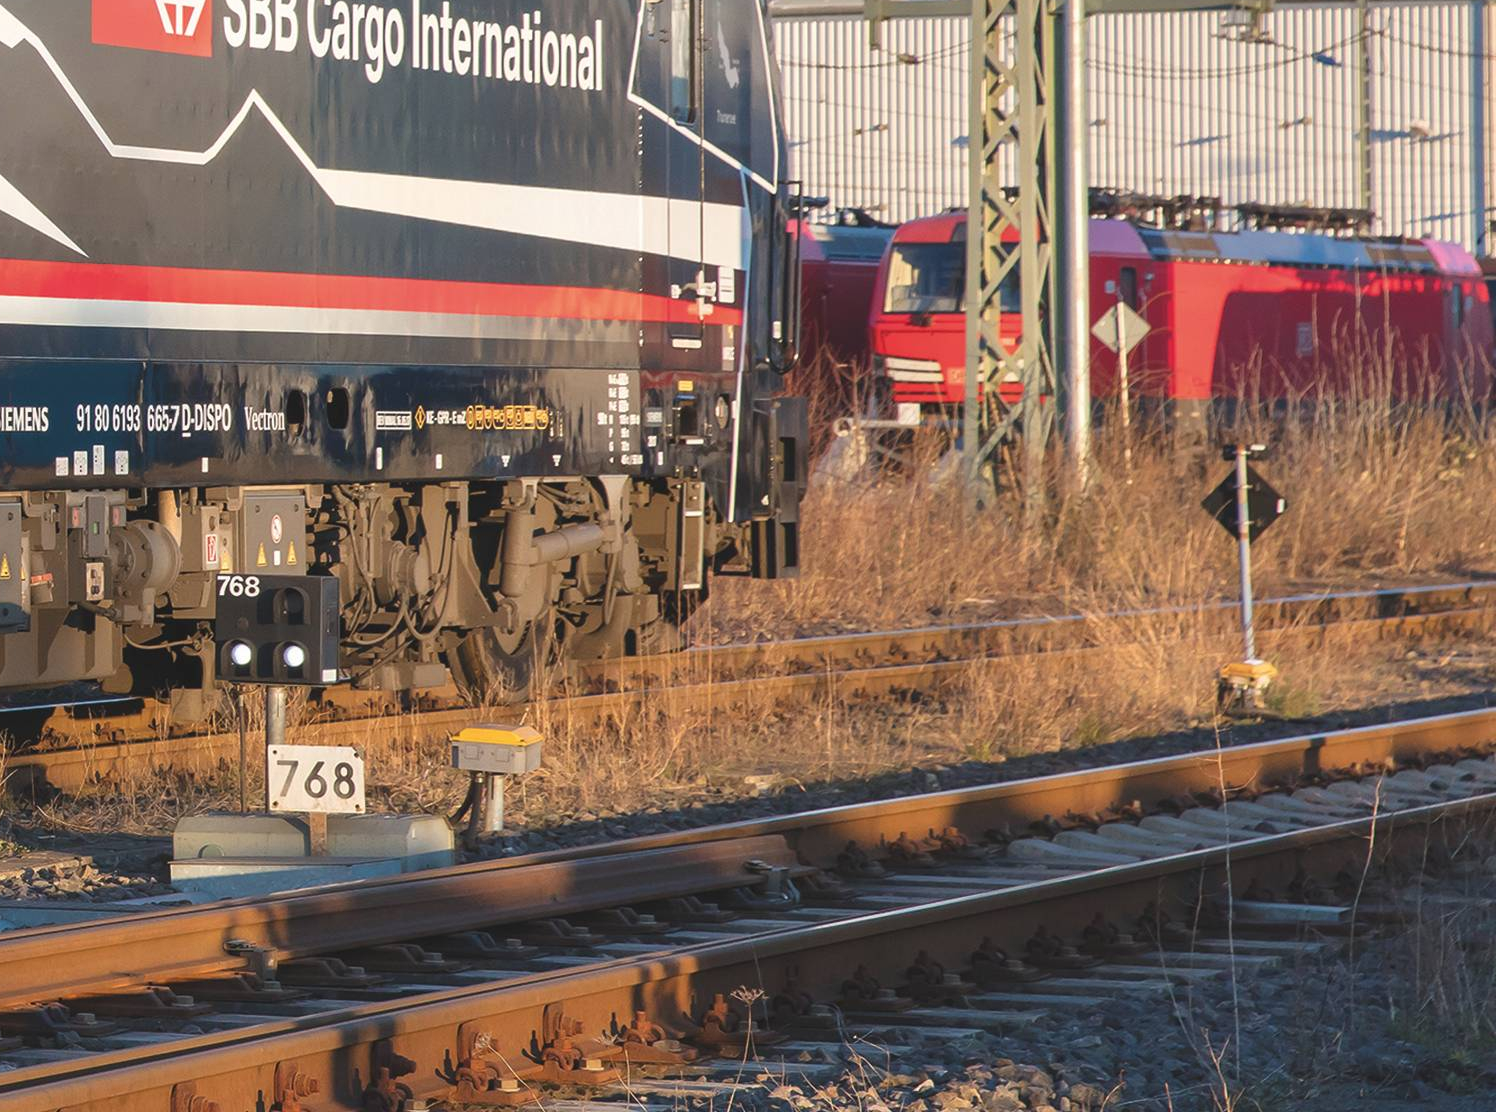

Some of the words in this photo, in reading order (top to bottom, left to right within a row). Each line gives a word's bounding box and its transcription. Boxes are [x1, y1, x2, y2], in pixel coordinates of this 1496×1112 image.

[76, 404, 91, 432] 91
[95, 404, 109, 432] 80
[112, 404, 141, 432] 6193
[147, 405, 180, 431] 665-7
[182, 404, 232, 436] D-DISPO
[244, 406, 286, 431] Vectron
[217, 575, 260, 597] 768
[276, 760, 356, 799] 768
